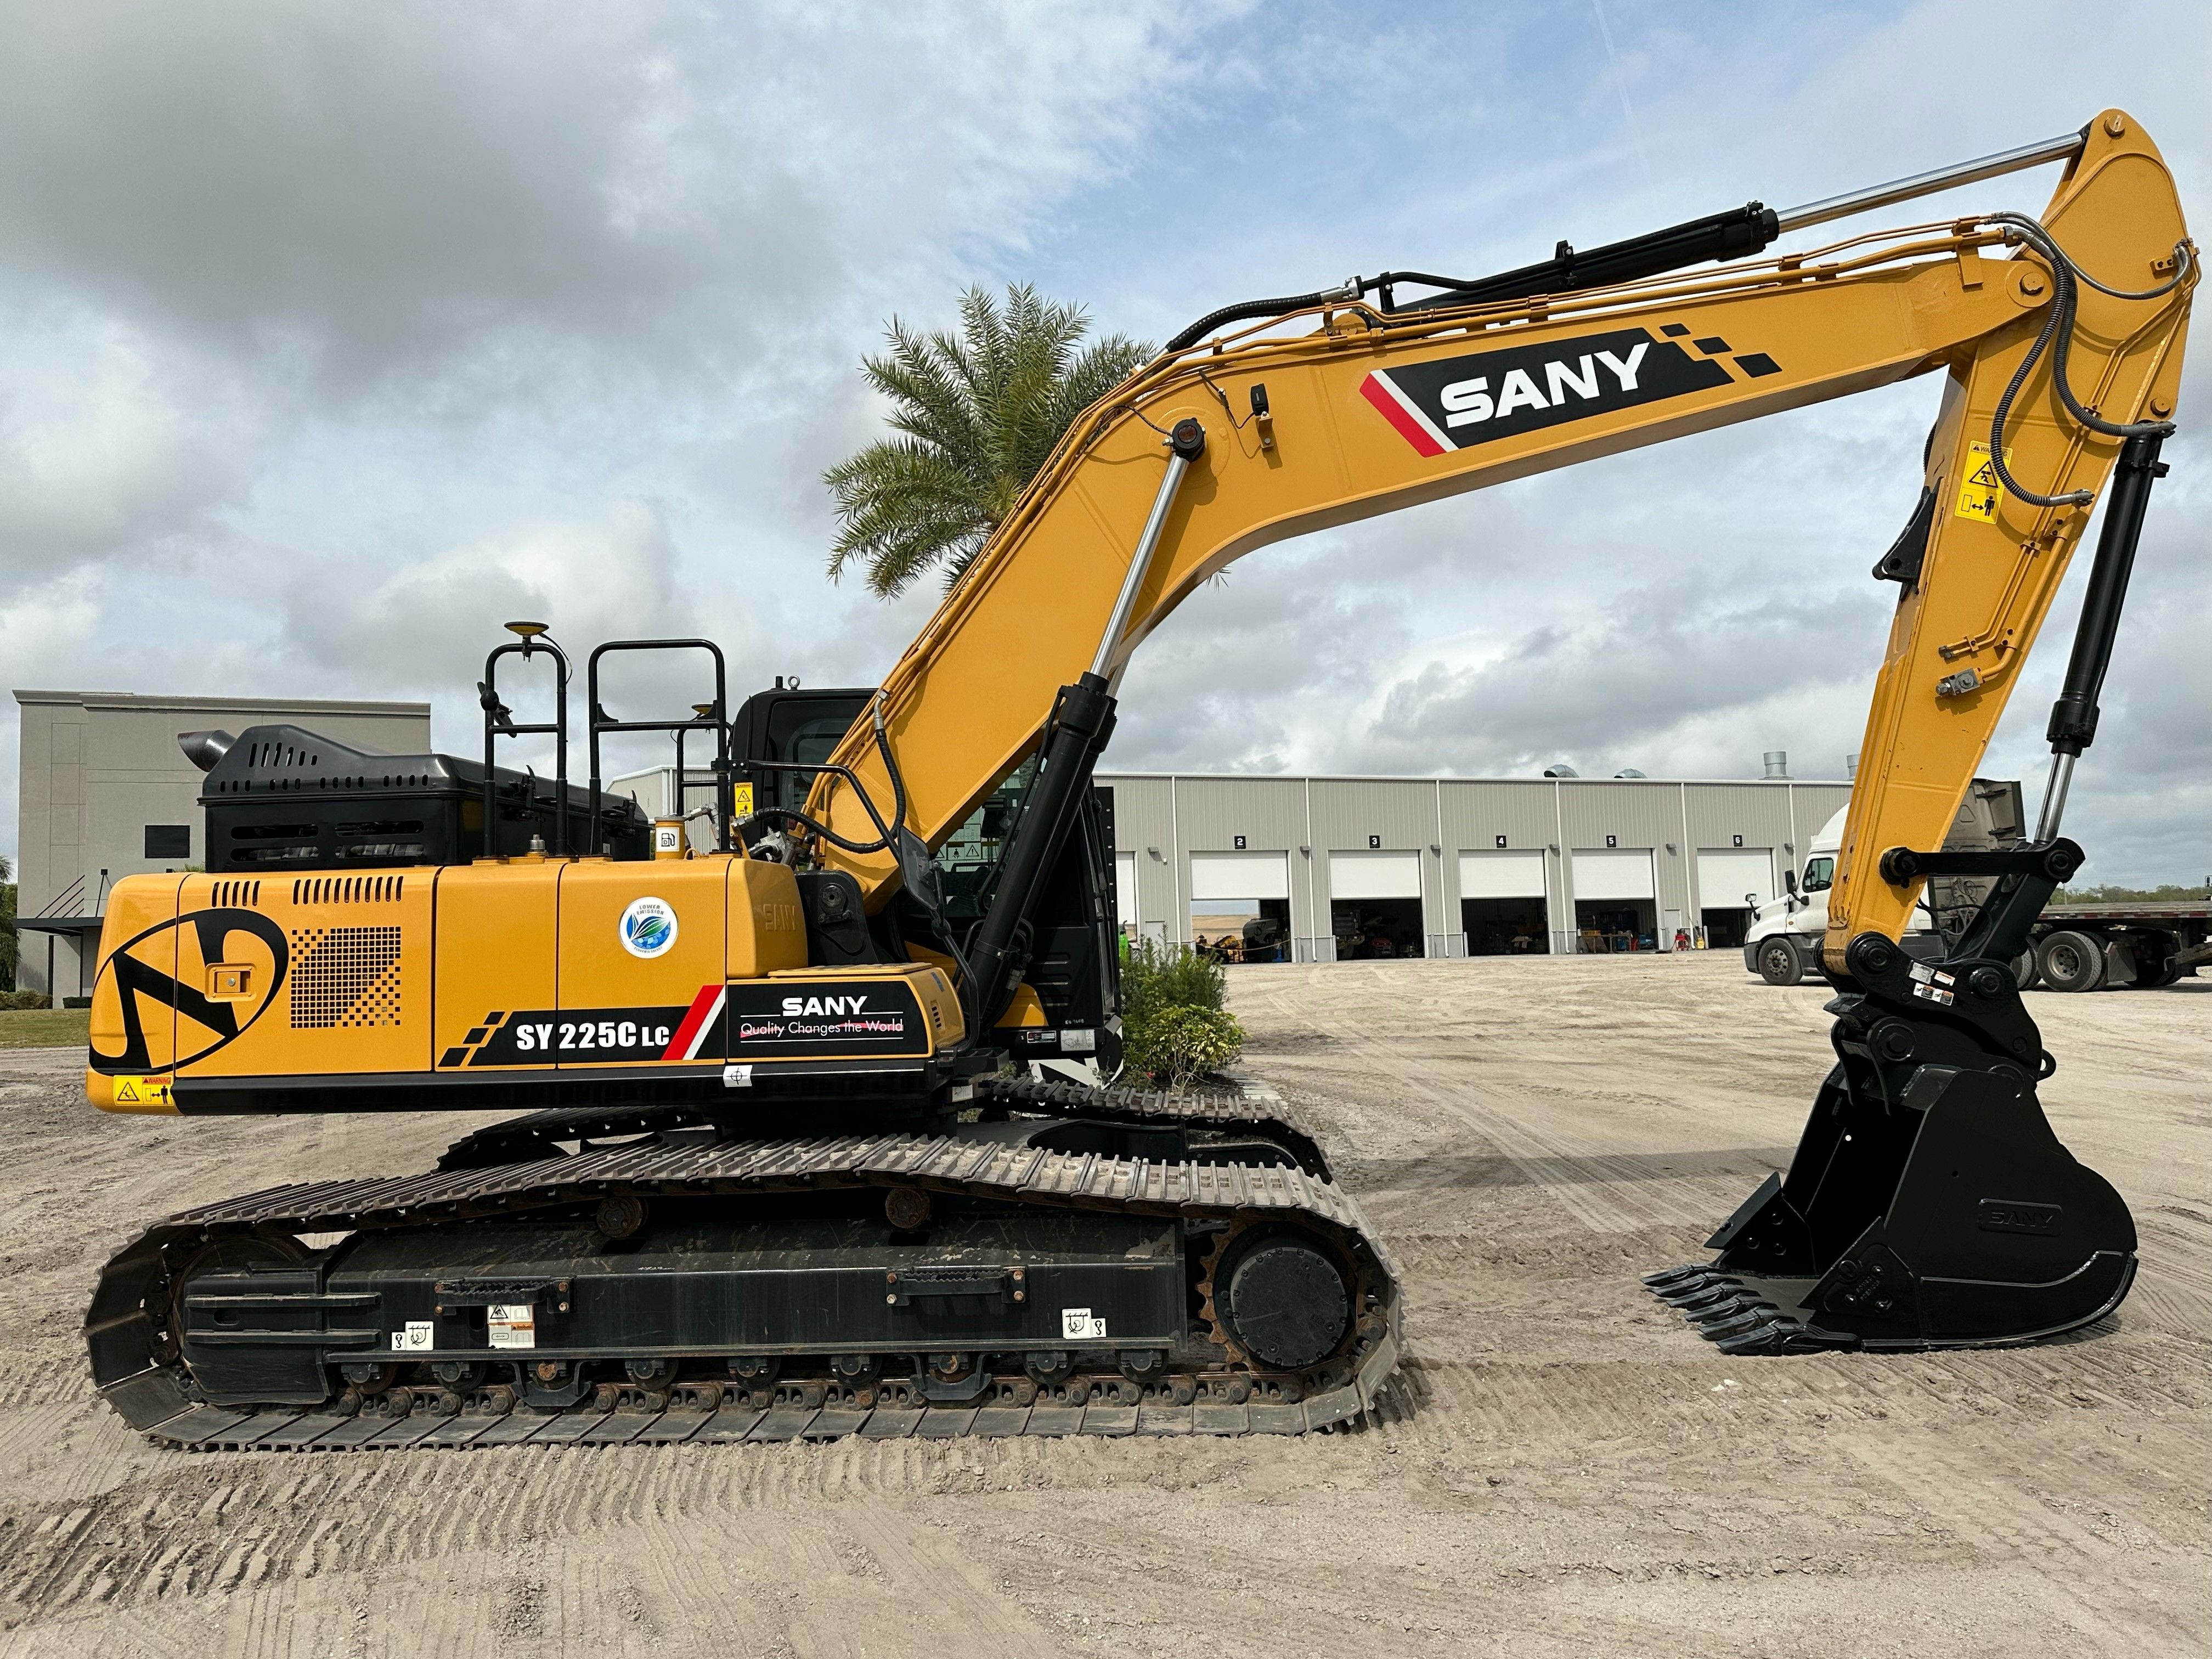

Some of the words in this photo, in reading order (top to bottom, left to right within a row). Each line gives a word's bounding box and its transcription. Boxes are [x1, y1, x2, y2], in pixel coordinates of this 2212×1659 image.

[1440, 342, 1650, 428] SANY
[763, 904, 795, 930] SANY
[782, 996, 868, 1017] SANY
[516, 1024, 554, 1050] SY
[741, 1021, 785, 1037] Quality
[788, 1020, 839, 1036] Changes
[844, 1019, 862, 1032] the
[865, 1018, 903, 1032] World
[1988, 1211, 2053, 1228] SANY
